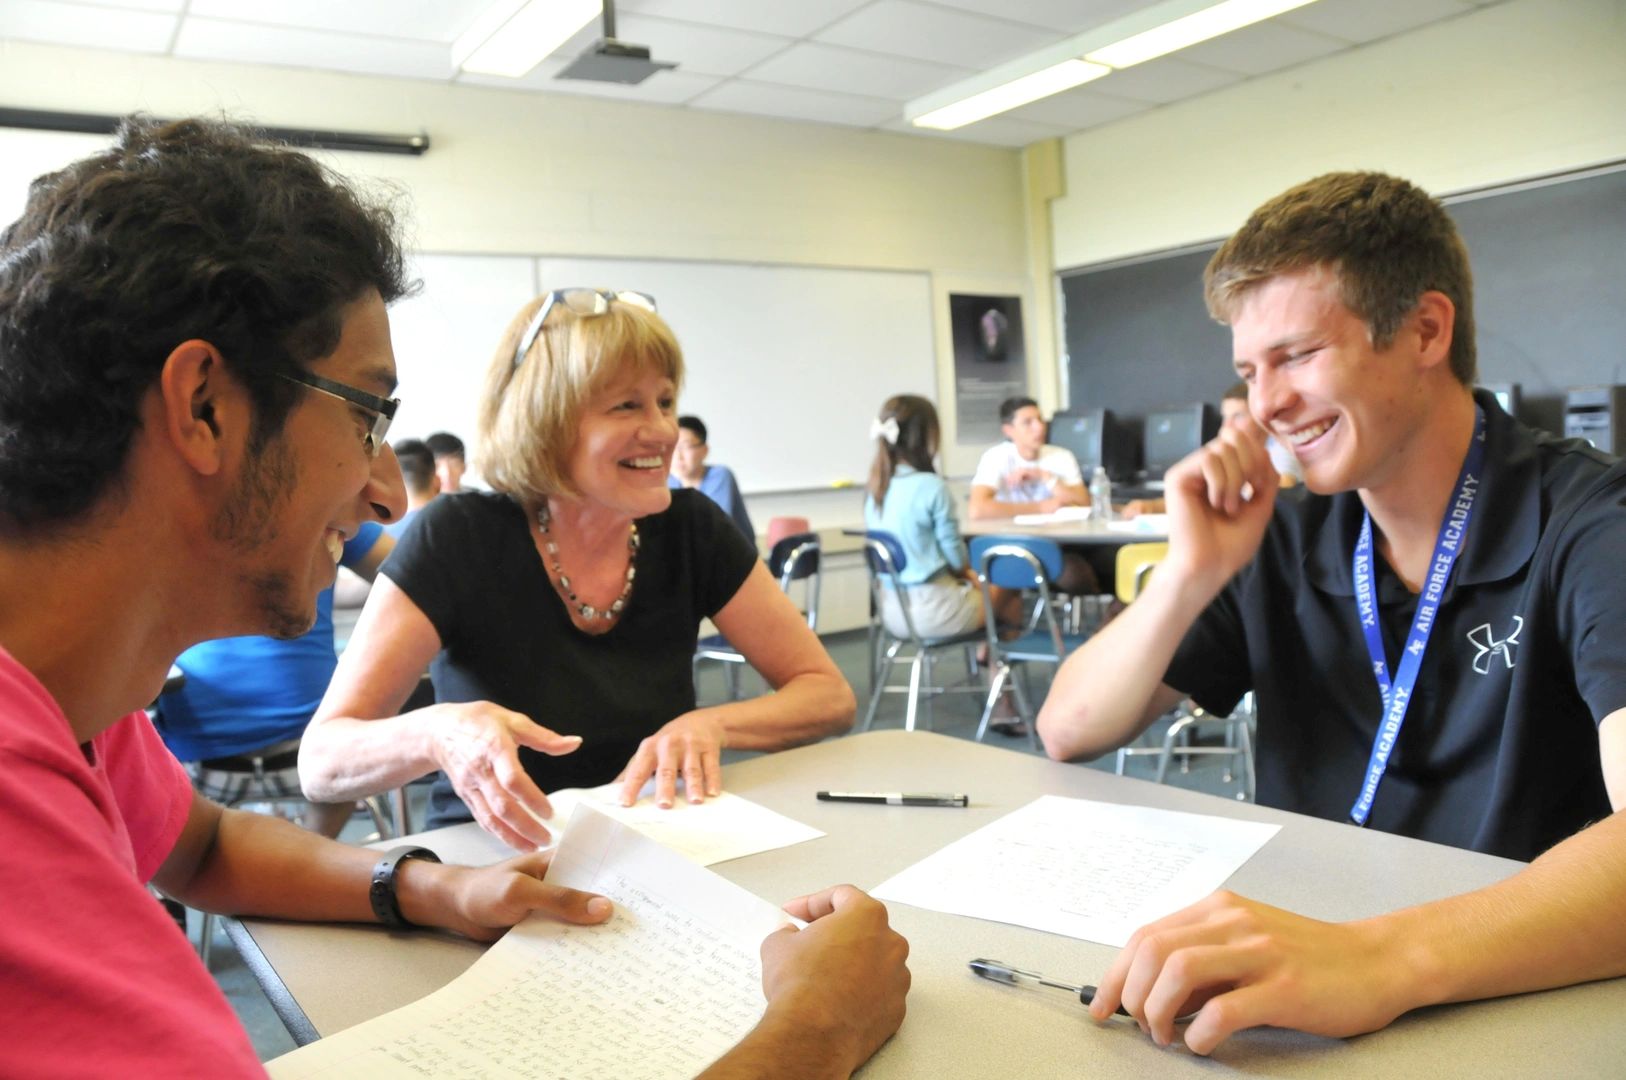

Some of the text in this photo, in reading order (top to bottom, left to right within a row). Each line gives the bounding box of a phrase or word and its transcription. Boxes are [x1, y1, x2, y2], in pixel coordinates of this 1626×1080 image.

[1355, 555, 1375, 625] ACADEMY
[1417, 603, 1434, 633] AIR
[1426, 555, 1453, 602] FORCE
[1442, 473, 1479, 550] ACADEMY
[1360, 766, 1384, 811] FORCE
[1376, 687, 1409, 766] ACADEMY
